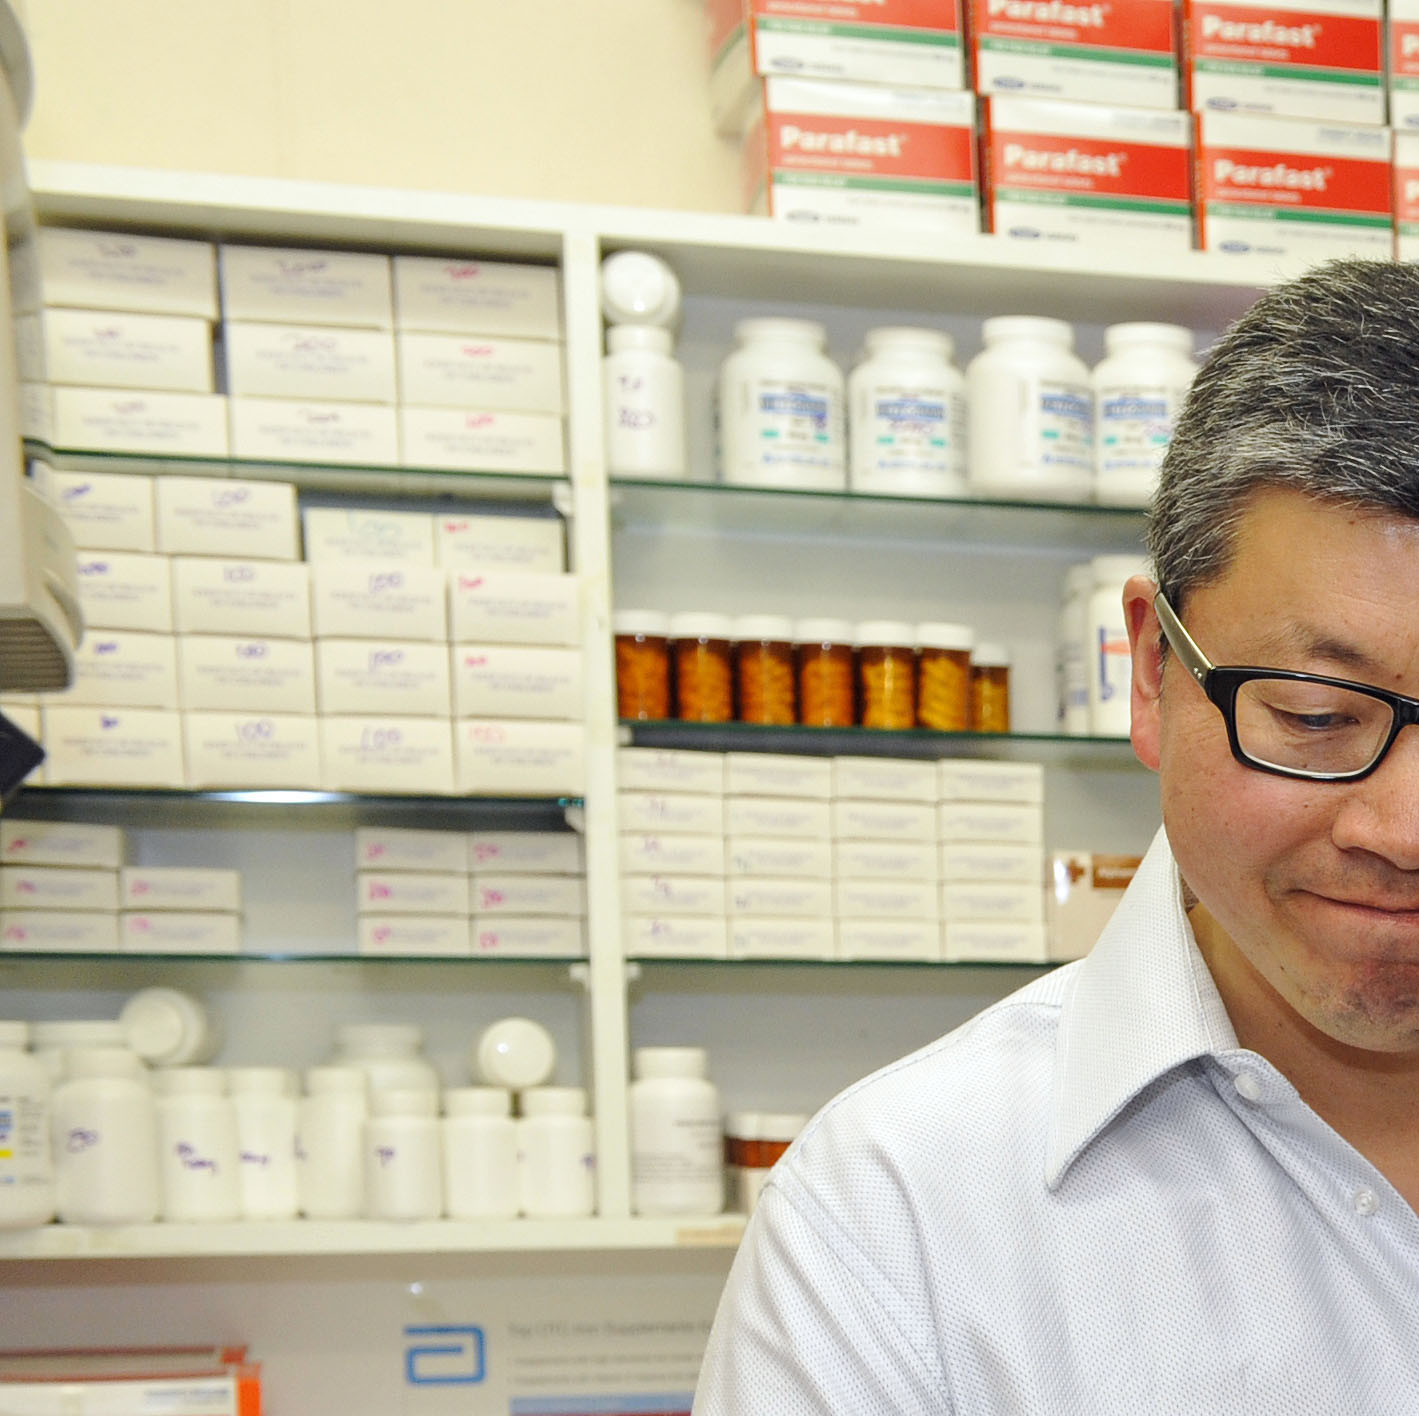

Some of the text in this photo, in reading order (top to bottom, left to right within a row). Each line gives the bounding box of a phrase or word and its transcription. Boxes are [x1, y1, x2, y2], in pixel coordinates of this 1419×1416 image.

[1201, 14, 1317, 49] Parafast
[779, 124, 902, 158] Parafast
[1003, 142, 1121, 177] Parafast
[1213, 158, 1328, 191] Parafast
